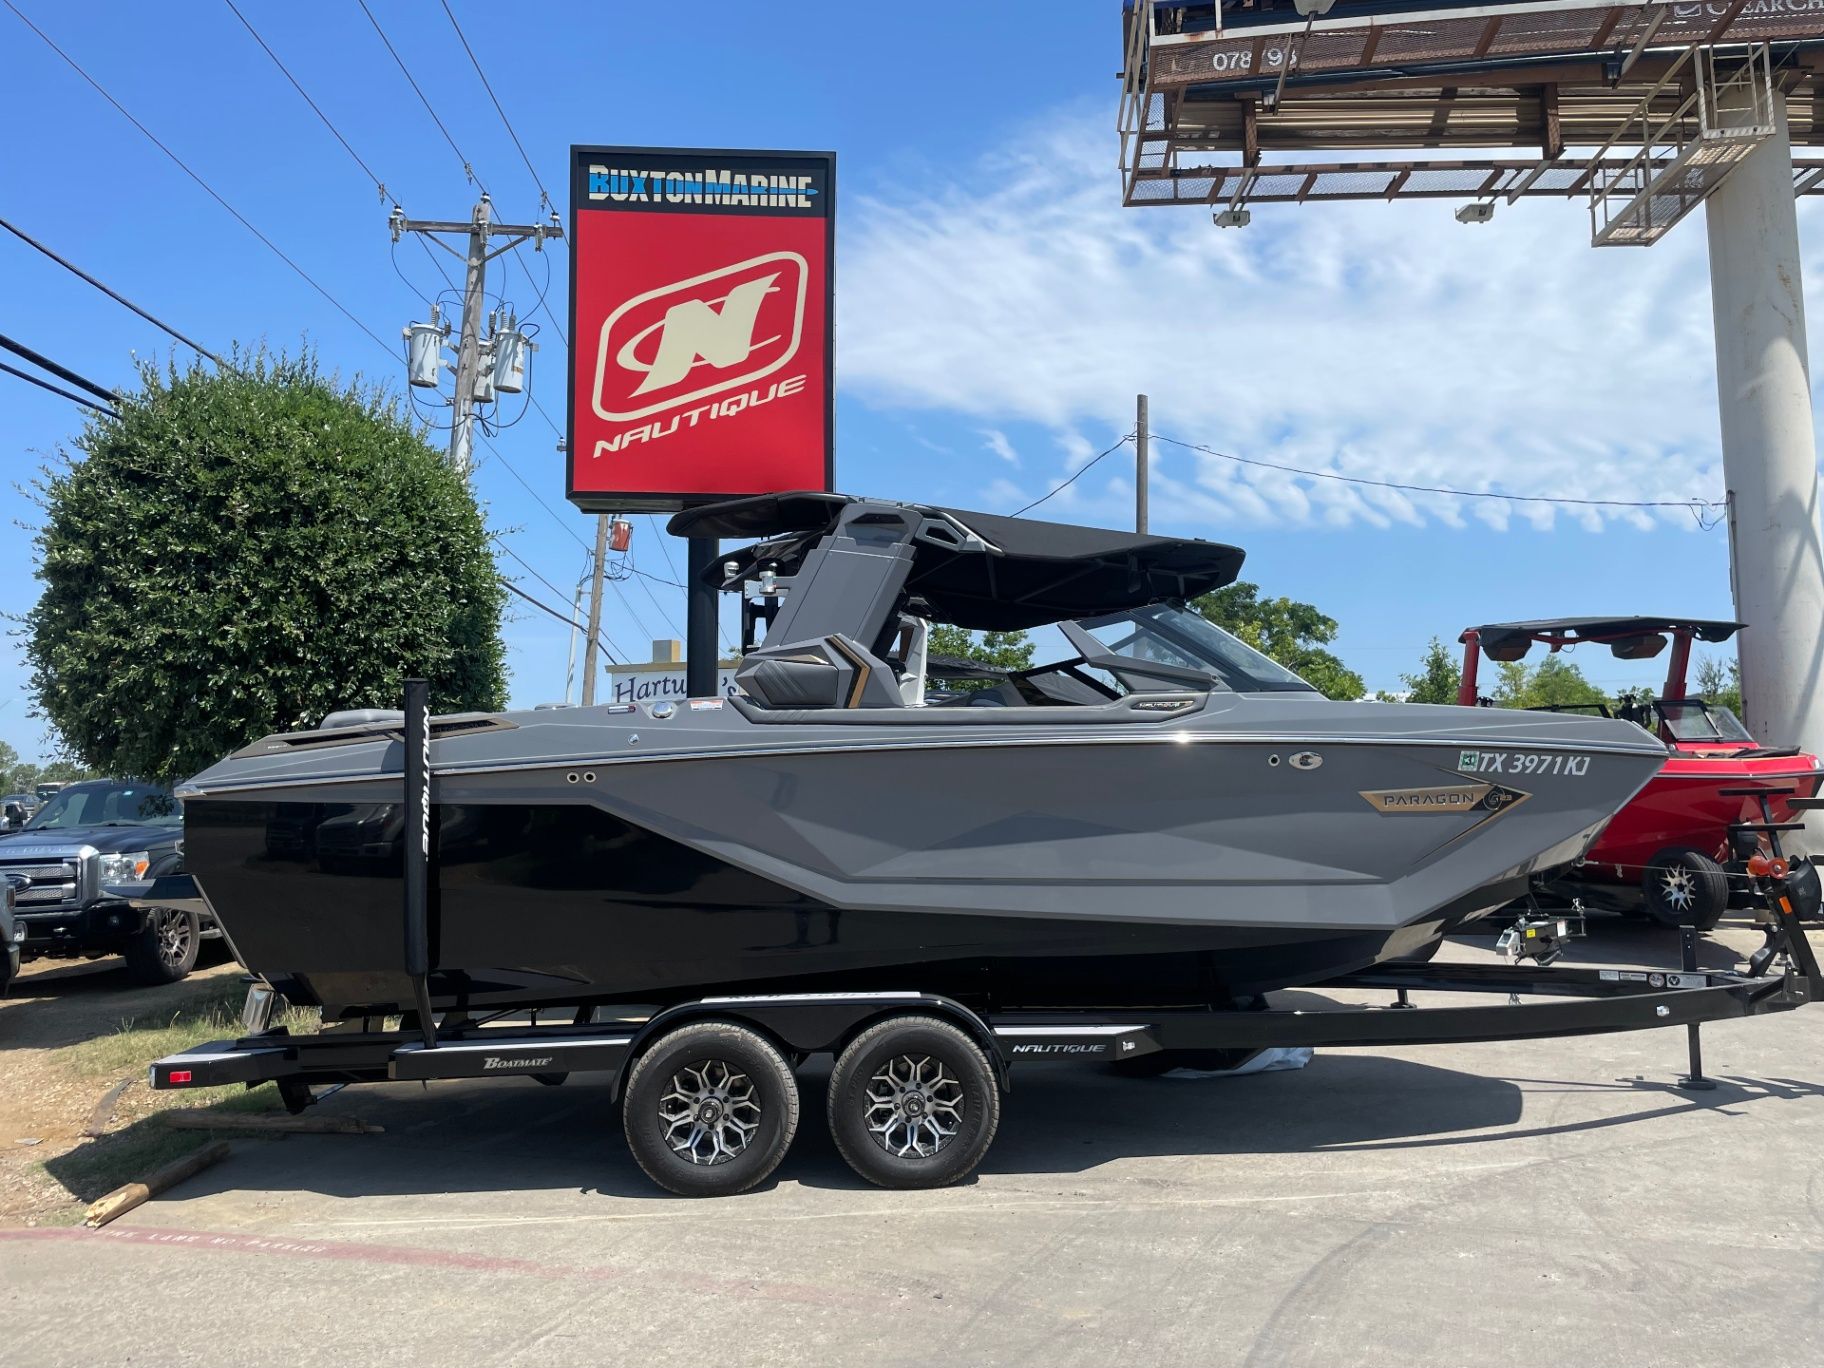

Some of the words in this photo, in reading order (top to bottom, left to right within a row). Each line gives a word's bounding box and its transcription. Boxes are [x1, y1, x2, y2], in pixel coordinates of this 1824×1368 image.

[1706, 0, 1824, 15] CEARCH
[592, 374, 807, 458] NAUTIQUE
[1480, 753, 1507, 773] TX
[1384, 793, 1474, 806] PARAGON
[1012, 1044, 1106, 1053] NAUTIQUE
